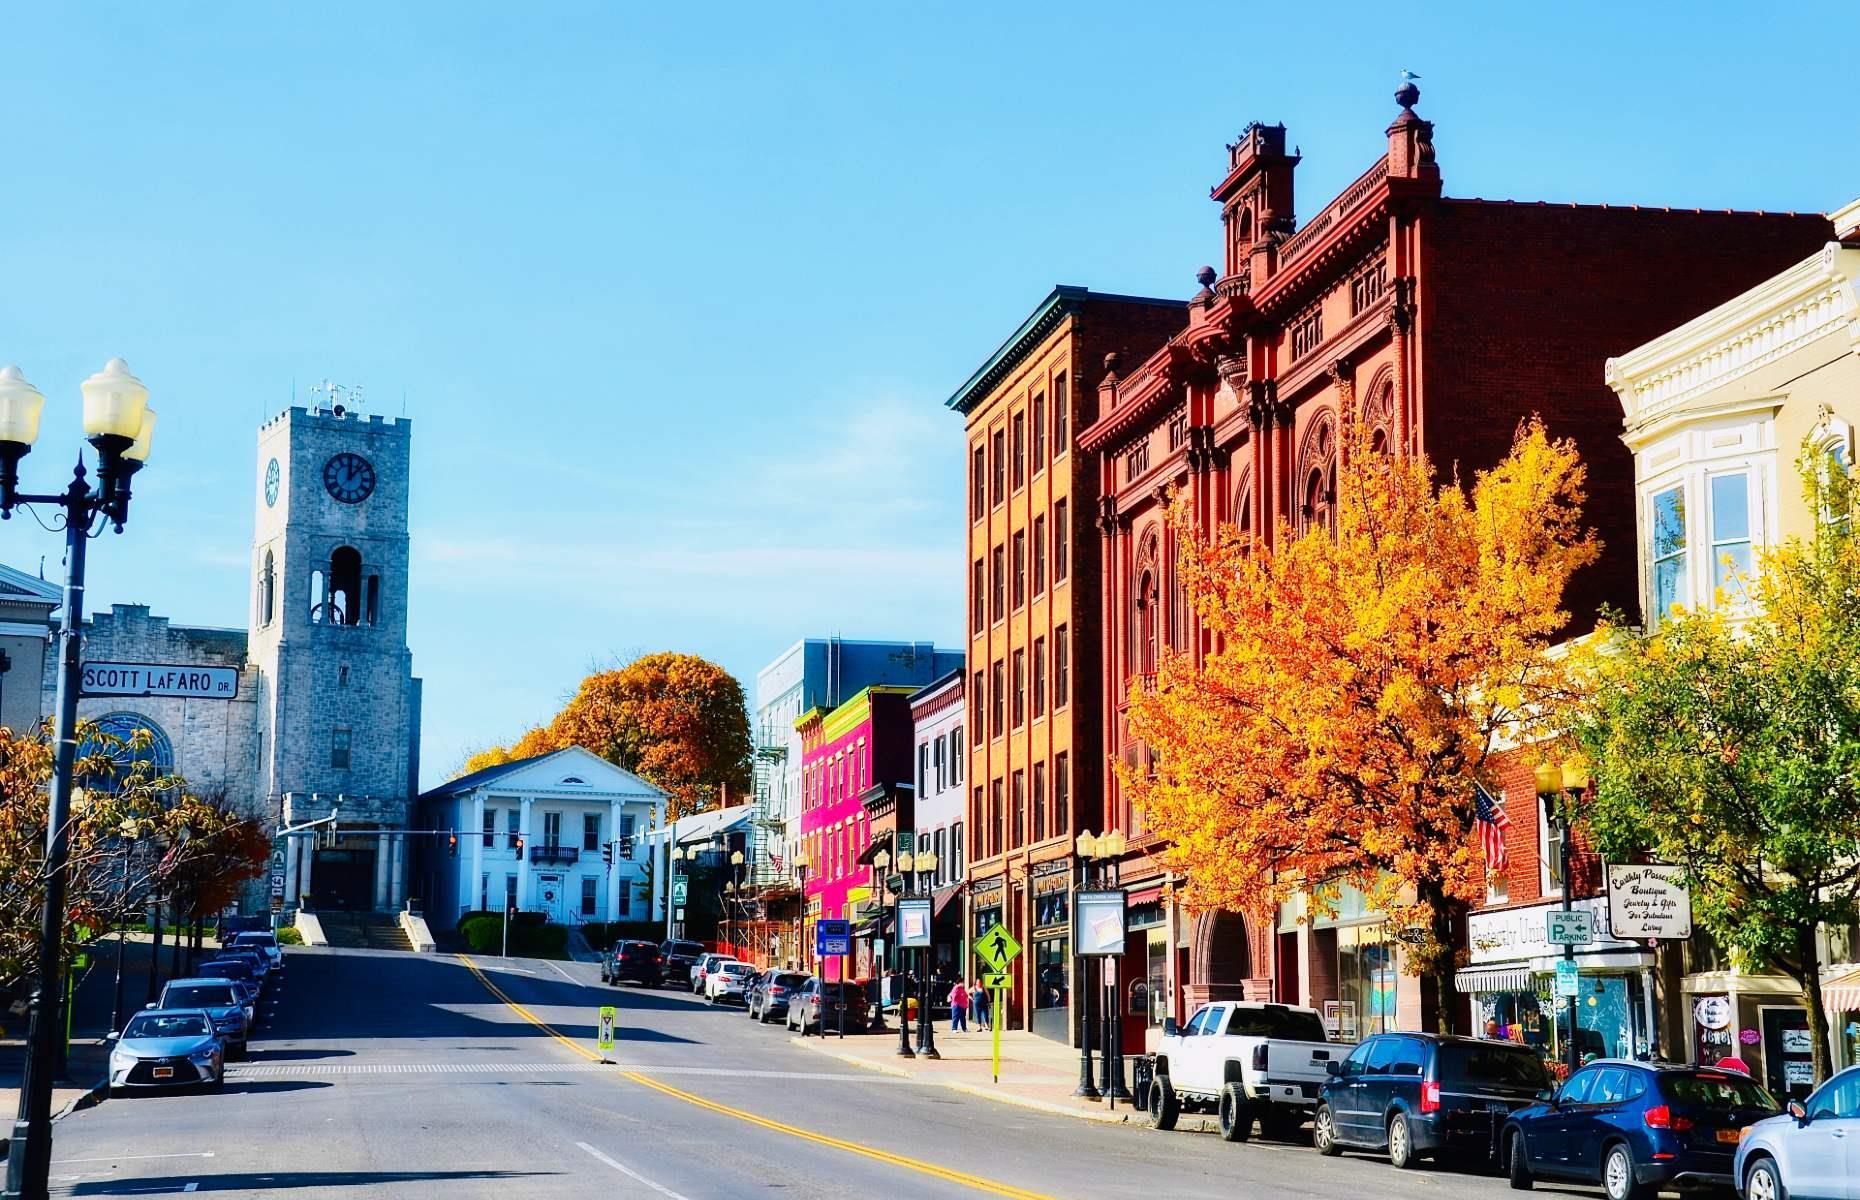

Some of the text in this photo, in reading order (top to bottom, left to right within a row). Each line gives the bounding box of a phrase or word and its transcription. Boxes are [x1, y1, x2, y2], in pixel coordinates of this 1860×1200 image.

[84, 668, 140, 688] SCOTT
[1631, 885, 1668, 898] Boutique
[1555, 914, 1583, 922] PUBLIC
[1519, 917, 1547, 947] Uniq
[1552, 924, 1588, 941] PARKING
